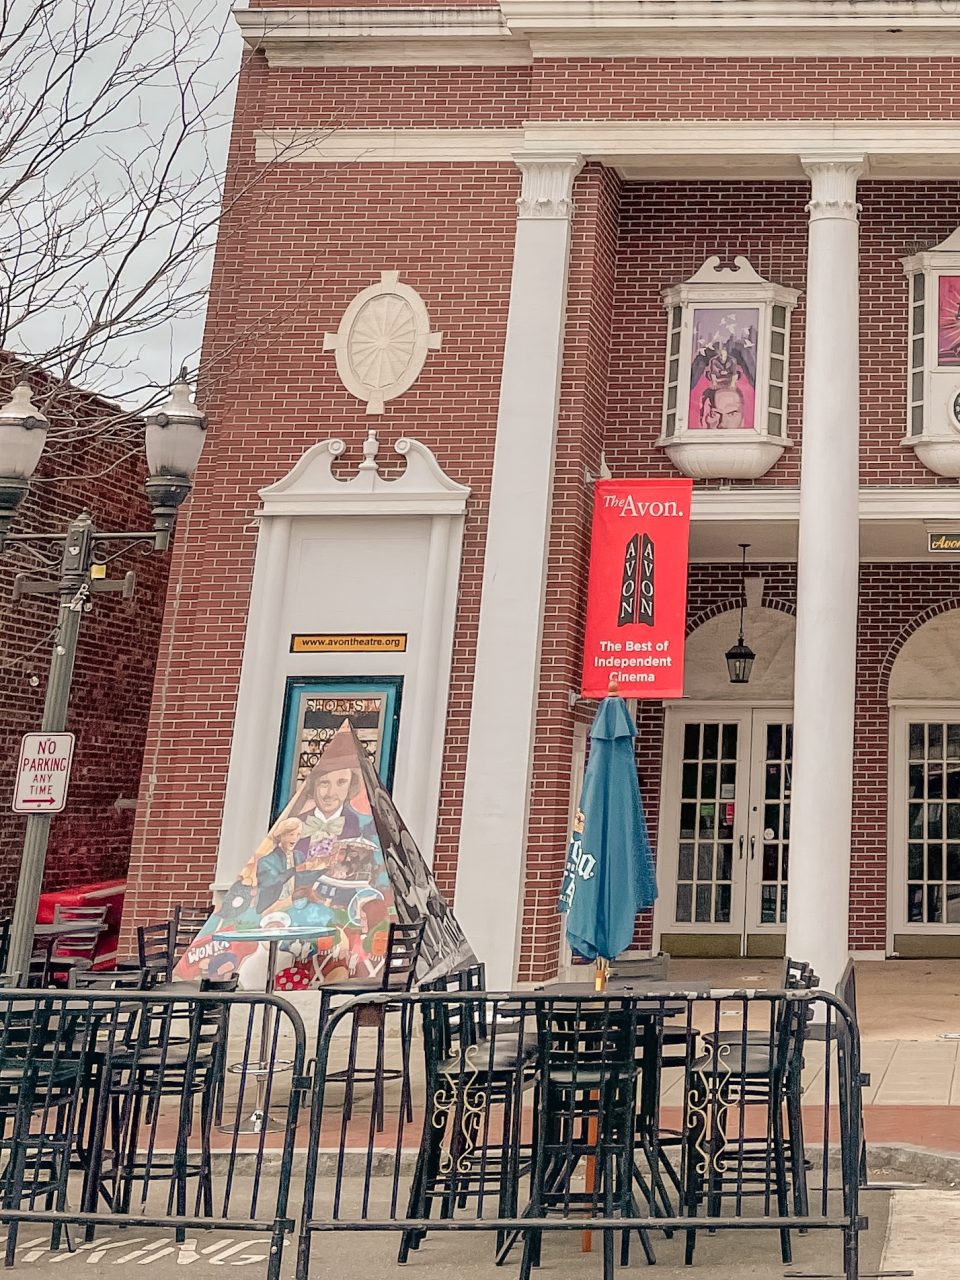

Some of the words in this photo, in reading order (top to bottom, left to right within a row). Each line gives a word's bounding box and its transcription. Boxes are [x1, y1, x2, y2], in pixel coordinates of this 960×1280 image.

[603, 495, 625, 508] The
[620, 543, 636, 618] AVON
[641, 543, 653, 617] AVON
[301, 637, 401, 648] www.avontheatre.org
[600, 641, 622, 652] The
[625, 641, 653, 652] Best
[656, 640, 669, 652] of
[594, 656, 672, 669] Independent
[608, 671, 655, 683] Cinema
[37, 741, 57, 755] NO
[22, 758, 67, 772] PARKING
[33, 774, 53, 783] ANY
[30, 785, 53, 795] TIME
